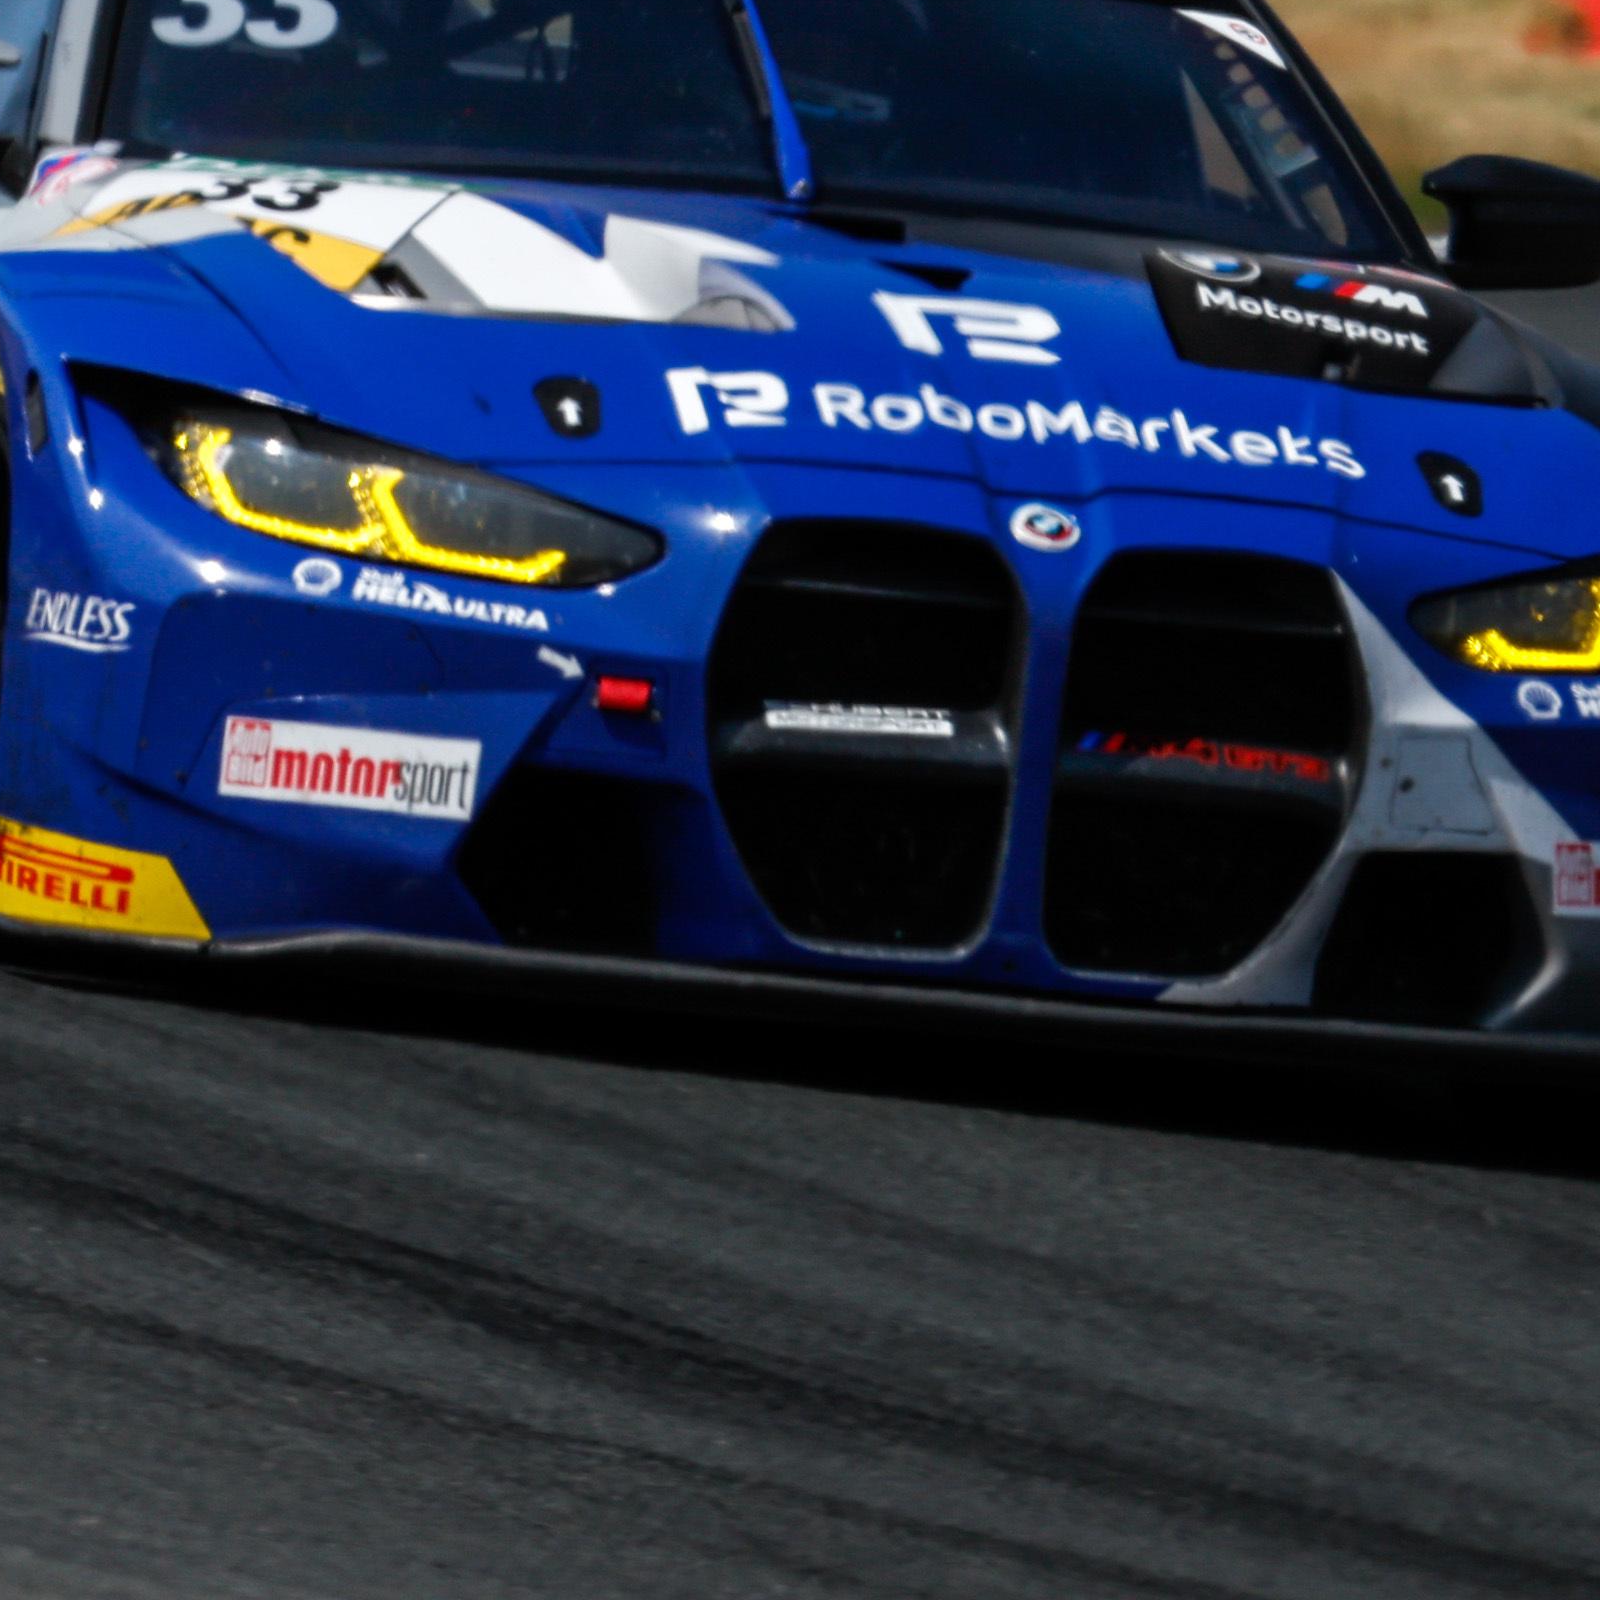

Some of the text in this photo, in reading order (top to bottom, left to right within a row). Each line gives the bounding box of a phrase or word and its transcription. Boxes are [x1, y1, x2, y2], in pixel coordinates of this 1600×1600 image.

[1196, 281, 1430, 356] Motorsport
[812, 380, 1366, 480] RoboMarkets
[24, 586, 138, 642] ENDLESS
[453, 596, 550, 633] ULTRA
[269, 745, 474, 814] motorsport
